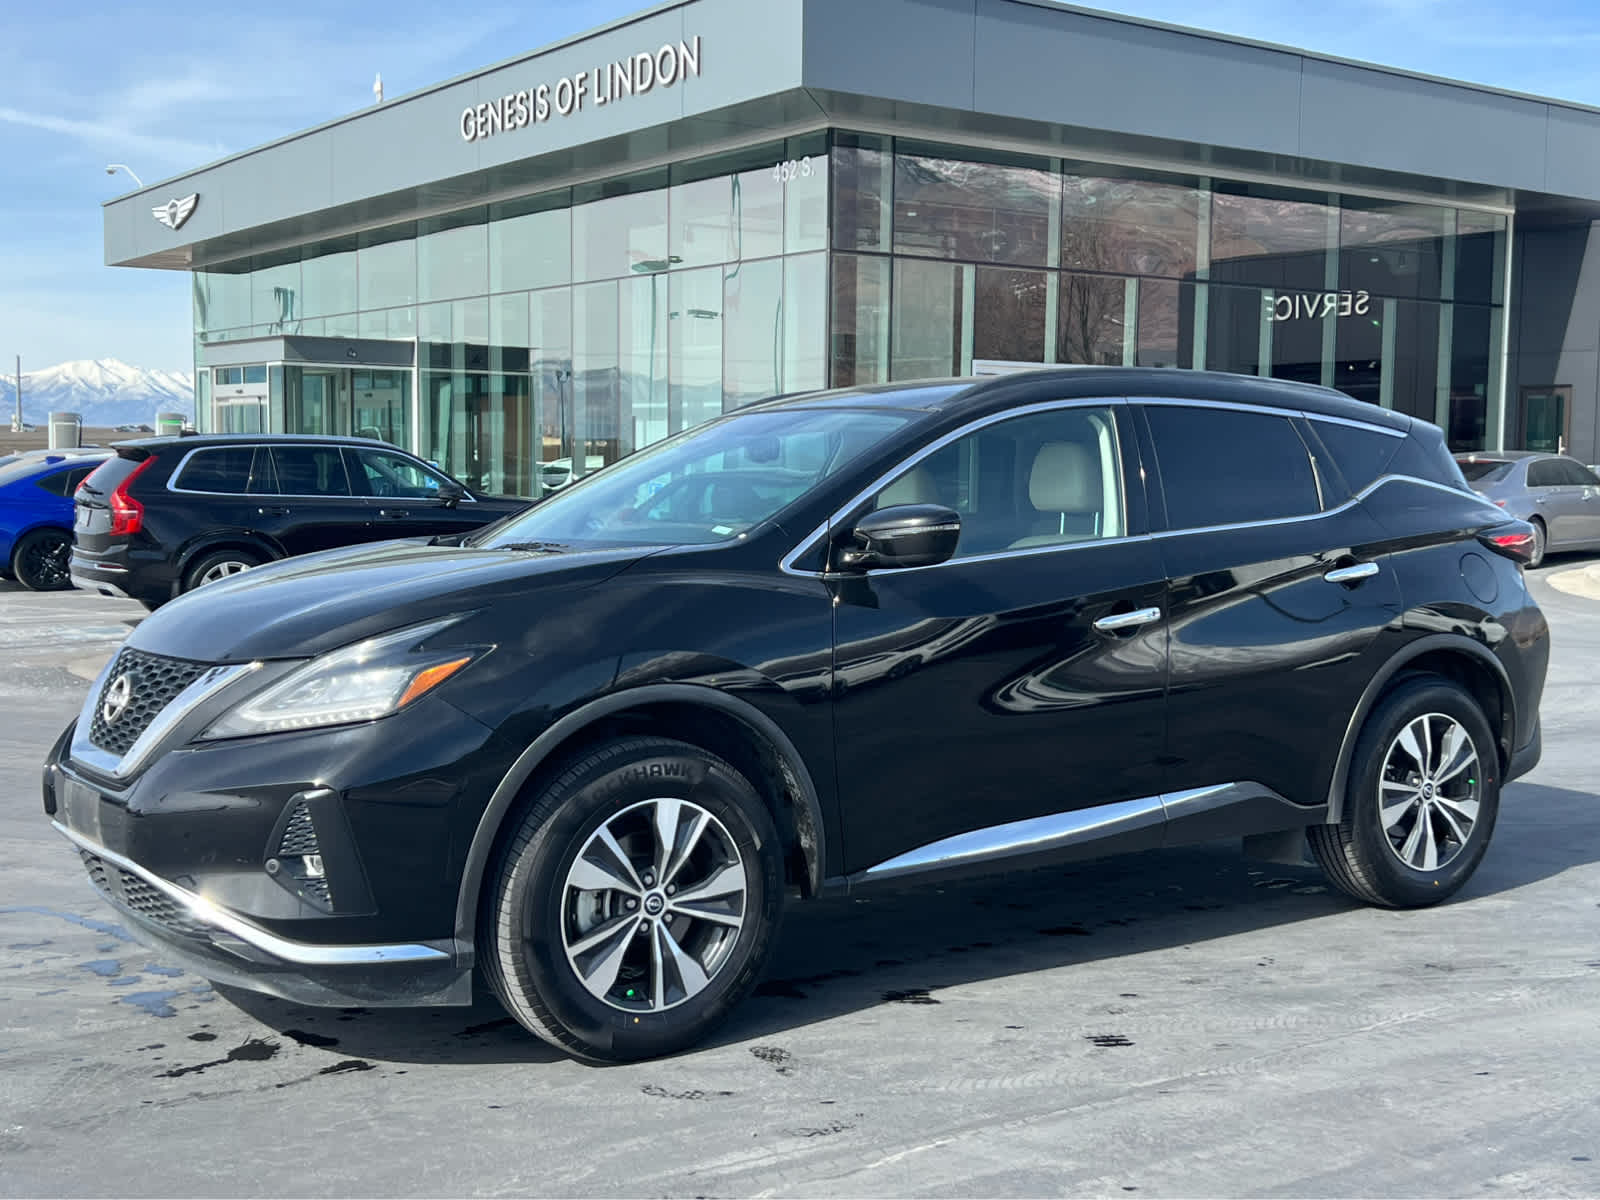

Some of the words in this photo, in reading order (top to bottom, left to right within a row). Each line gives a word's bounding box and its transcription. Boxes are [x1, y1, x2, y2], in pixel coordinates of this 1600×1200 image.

[460, 84, 551, 142] GENESIS
[555, 71, 588, 115] OF
[593, 35, 701, 105] LINDON
